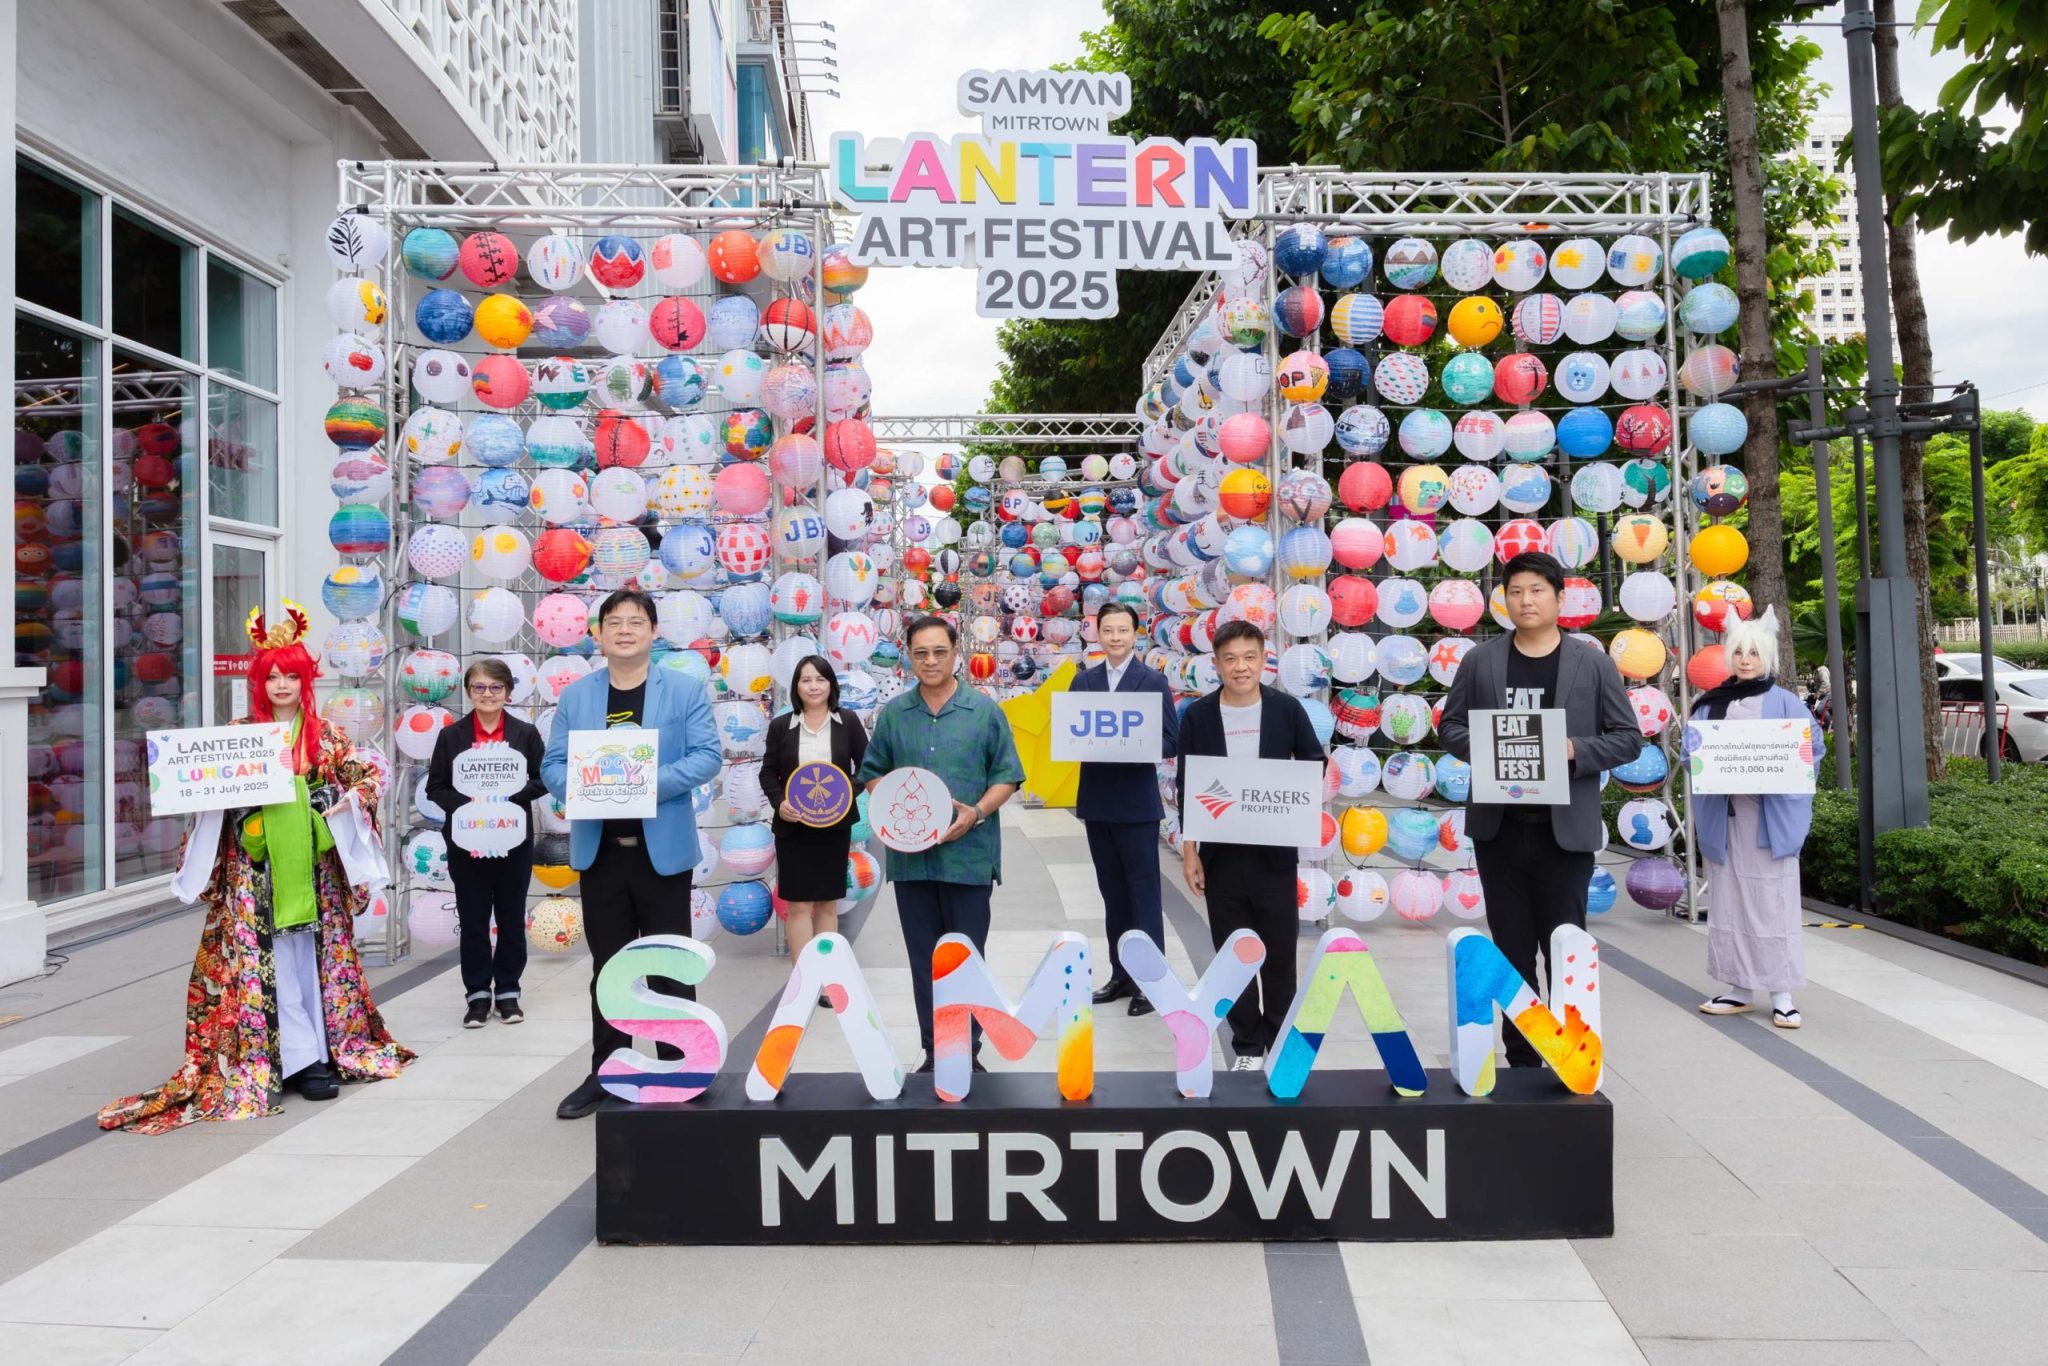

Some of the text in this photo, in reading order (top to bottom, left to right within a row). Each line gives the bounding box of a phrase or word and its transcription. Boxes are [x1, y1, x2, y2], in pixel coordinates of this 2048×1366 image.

[968, 77, 1123, 106] SAMYAN
[992, 115, 1100, 132] MITRTOWN
[838, 139, 1248, 209] LANTERN
[858, 217, 1233, 262] ART FESTIVAL
[985, 270, 1110, 310] 2025
[1276, 371, 1305, 388] OP
[1070, 710, 1144, 738] JBP
[1496, 716, 1529, 736] EAT
[177, 736, 264, 754] LANTERN
[1498, 742, 1540, 758] RAMEN
[168, 749, 275, 766] ART FESTIVAL 2025
[177, 762, 268, 784] LUMIGAMI
[461, 763, 519, 773] LANTERN
[1499, 760, 1540, 779] FEST
[1740, 765, 1765, 774] 3,000
[180, 788, 193, 799] 18
[204, 787, 216, 796] 31
[220, 783, 241, 795] July
[244, 781, 269, 792] 2025
[1241, 788, 1310, 805] FRASERS
[1241, 804, 1291, 815] PROPERTY
[596, 924, 1604, 1104] SAMYAN
[759, 1129, 1448, 1227] MITRTOWN
